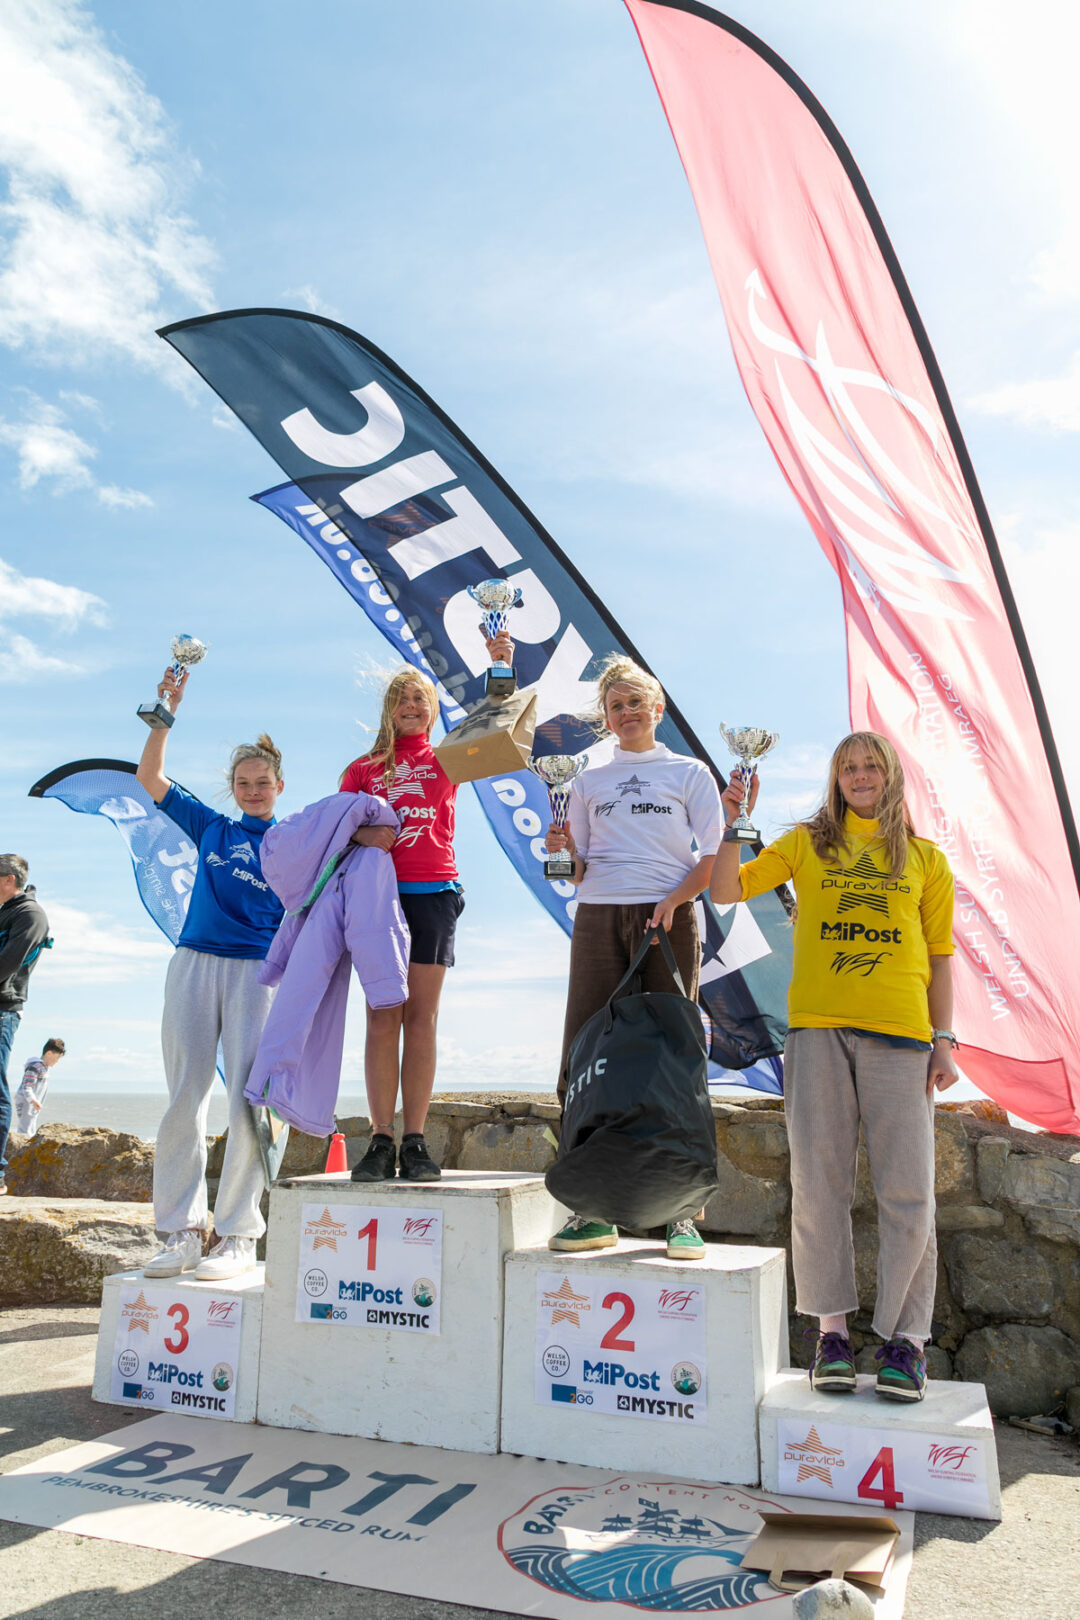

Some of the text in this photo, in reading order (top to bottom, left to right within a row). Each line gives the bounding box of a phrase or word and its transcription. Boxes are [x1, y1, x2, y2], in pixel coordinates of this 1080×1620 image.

[631, 802, 672, 815] MiPost
[232, 867, 268, 891] MiPost
[821, 876, 911, 894] puravida
[820, 921, 902, 945] MiPost
[964, 931, 1011, 1021] WELSH
[358, 1218, 378, 1271] 1
[338, 1280, 403, 1305] MiPost
[541, 1299, 591, 1311] puravida
[164, 1302, 190, 1355] 3
[379, 1310, 430, 1329] MYSTIC
[600, 1291, 635, 1352] 2
[148, 1361, 204, 1388] MiPost
[583, 1360, 660, 1392] MiPost
[181, 1393, 226, 1412] MYSTIC
[632, 1397, 694, 1419] MYSTIC
[784, 1452, 845, 1467] puravida
[85, 1440, 478, 1526] BARTI
[857, 1446, 904, 1510] 4
